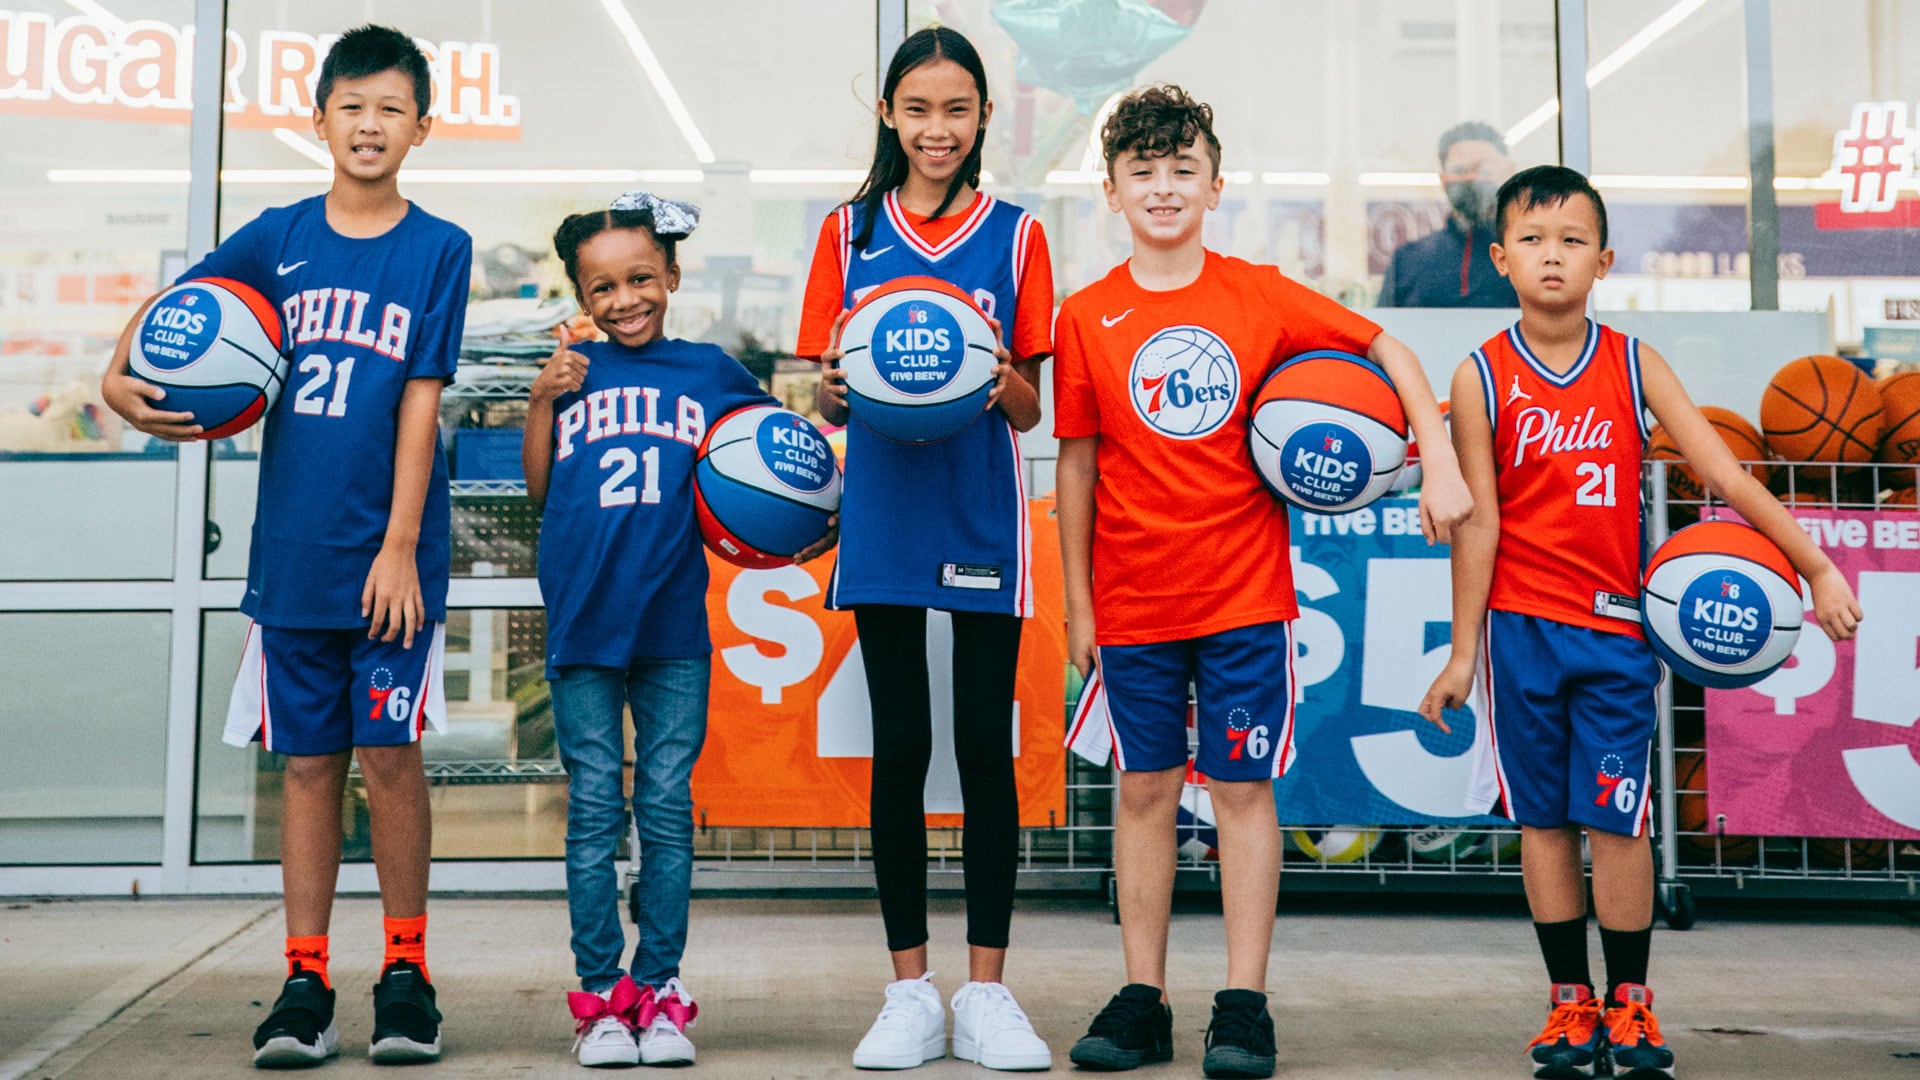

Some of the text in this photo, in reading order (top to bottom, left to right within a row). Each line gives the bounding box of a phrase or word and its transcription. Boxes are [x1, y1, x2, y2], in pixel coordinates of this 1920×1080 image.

[151, 306, 207, 334] KIDS
[283, 287, 411, 361] PHILA
[908, 310, 928, 323] 76
[154, 329, 186, 345] CLUB
[886, 328, 950, 352] KIDS
[890, 371, 913, 381] five
[900, 355, 939, 367] CLUB
[294, 354, 356, 416] 21
[557, 386, 706, 461] PHILA
[1514, 406, 1612, 467] Phila
[773, 427, 827, 459] KIDS
[785, 449, 818, 468] CLUB
[599, 446, 661, 508] 21
[1294, 447, 1359, 482] KIDS
[1303, 476, 1341, 492] CLUB
[1575, 462, 1616, 507] 21
[1721, 582, 1740, 599] 76
[1694, 597, 1759, 631] KIDS
[1704, 627, 1744, 644] CLUB
[369, 686, 411, 722] 76
[1226, 725, 1270, 760] 76
[1594, 771, 1637, 813] 76
